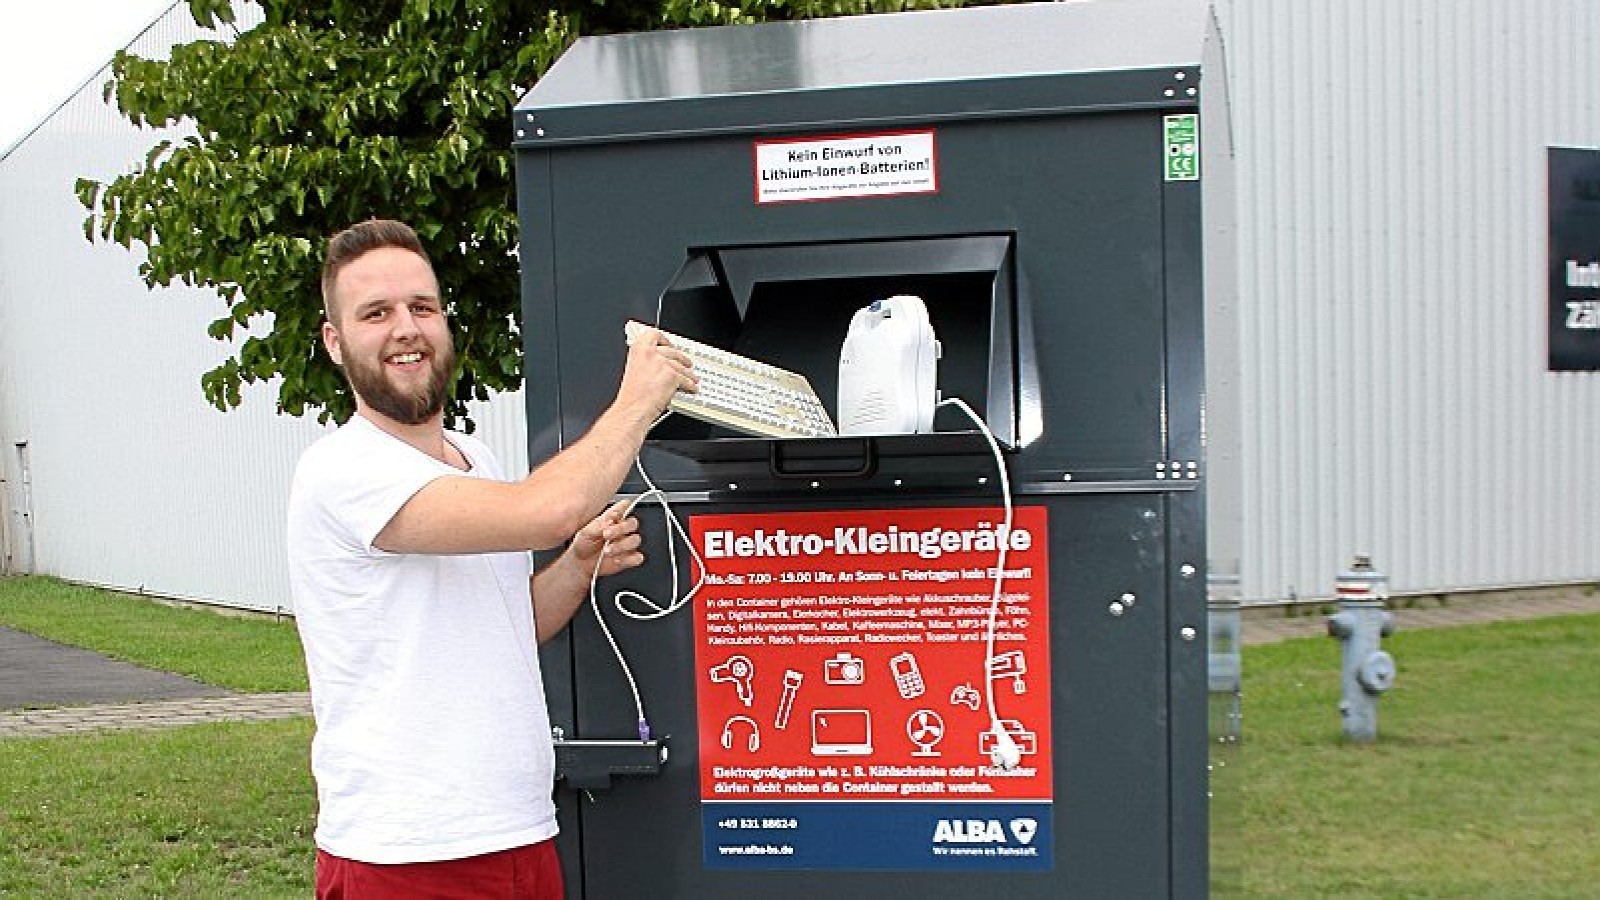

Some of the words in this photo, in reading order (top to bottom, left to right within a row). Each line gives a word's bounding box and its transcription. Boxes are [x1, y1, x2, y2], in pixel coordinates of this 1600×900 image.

[787, 149, 818, 163] Kein
[823, 144, 873, 160] Einwurf
[878, 145, 902, 155] von
[762, 158, 930, 181] Lithium-Ionen-Batterien!
[704, 521, 1031, 559] Elektro-Kleingeräte
[839, 571, 853, 582] An
[889, 571, 899, 580] u.
[901, 569, 959, 582] Feiertagen
[961, 567, 985, 578] kein
[949, 606, 1003, 617] Zahnbürs,
[957, 619, 1011, 630] MP3-Plyer,
[961, 631, 979, 641] und
[817, 765, 837, 776] wie
[841, 767, 851, 777] z.
[853, 765, 867, 776] B.
[869, 765, 947, 776] Kühlschränke
[949, 765, 975, 776] oder
[715, 781, 749, 792] dürfen
[753, 781, 781, 792] nicht
[785, 781, 819, 792] neben
[822, 781, 839, 792] die
[843, 781, 899, 792] Container
[901, 781, 945, 794] gestellt
[947, 781, 994, 792] werden.
[933, 819, 1007, 842] ALBA
